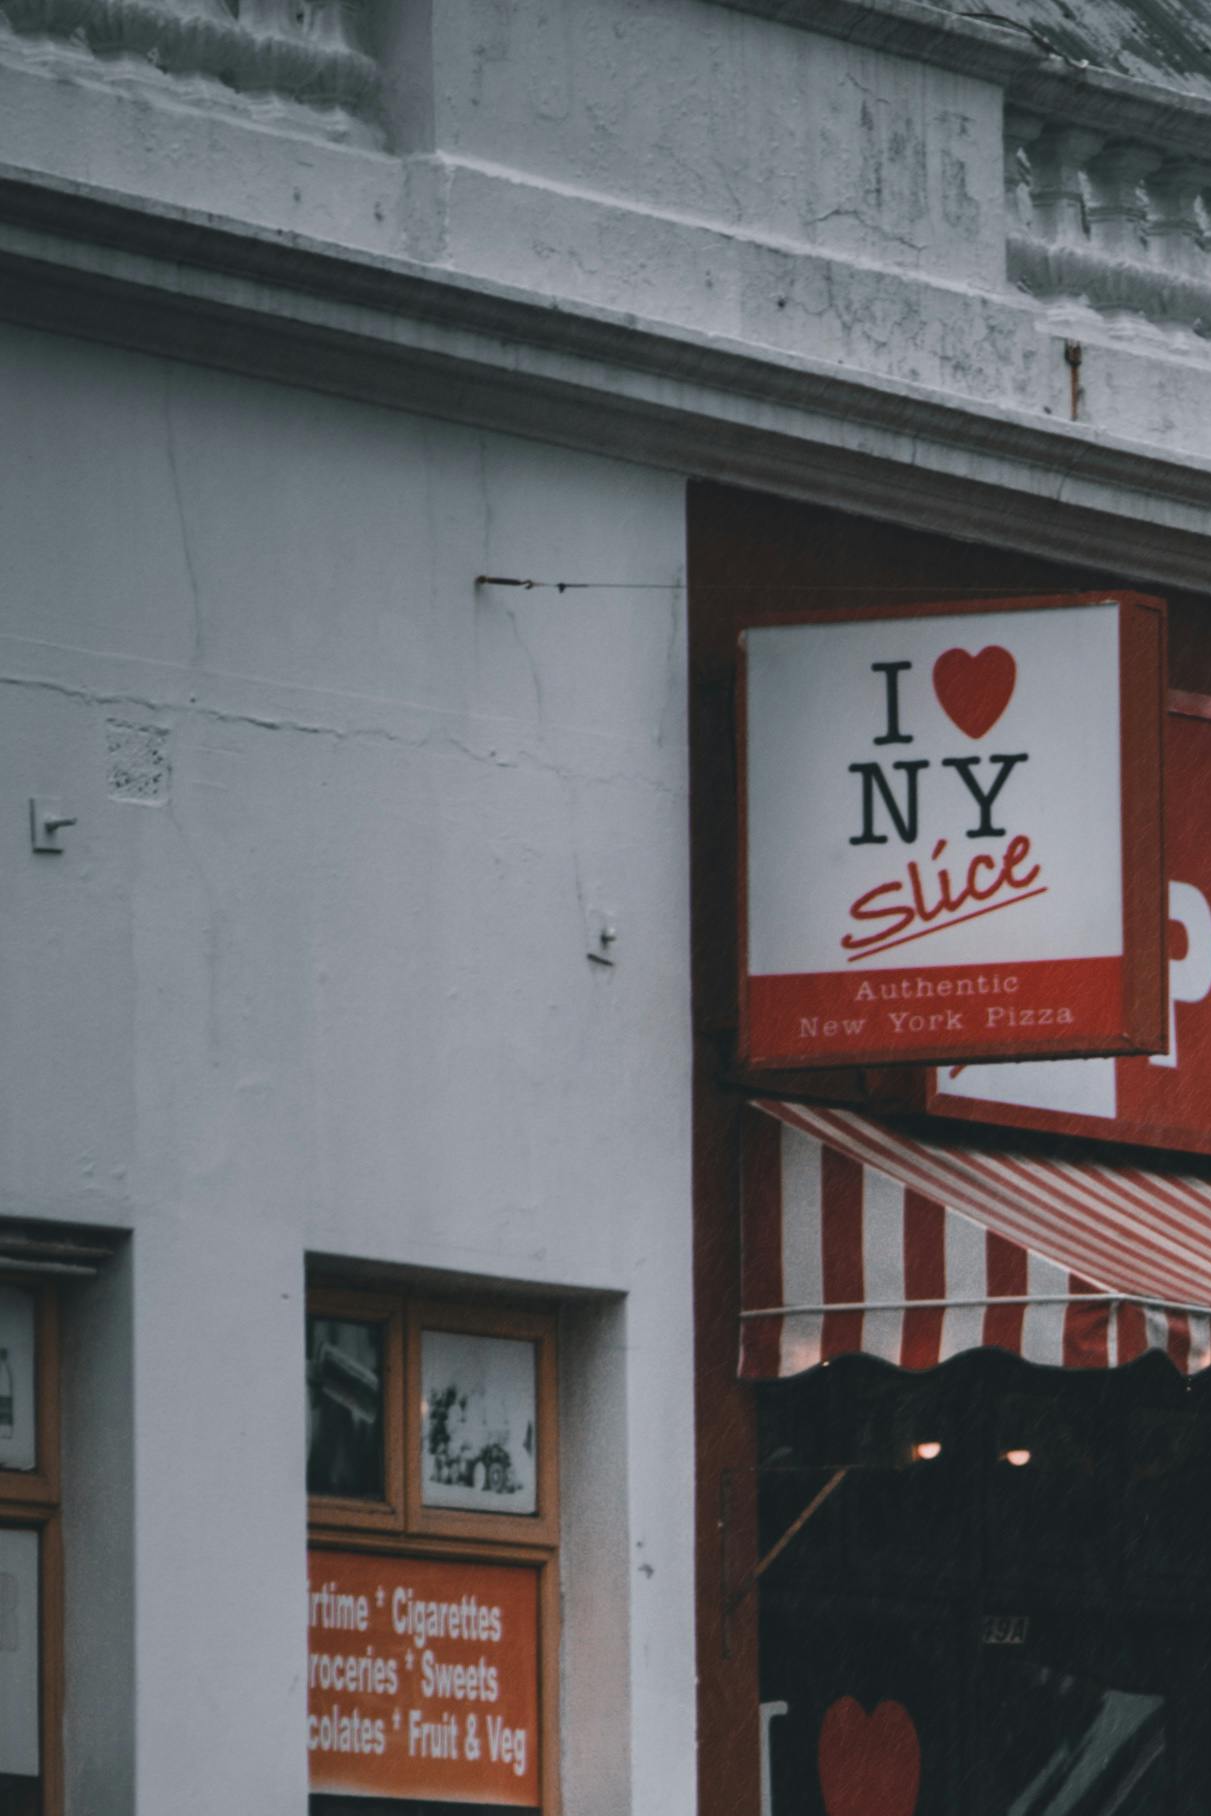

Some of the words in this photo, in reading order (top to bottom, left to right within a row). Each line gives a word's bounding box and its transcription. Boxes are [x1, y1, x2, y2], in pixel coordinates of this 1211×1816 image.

[871, 661, 914, 745] I
[849, 754, 1029, 846] NY
[854, 973, 1020, 1002] Authentic
[799, 1016, 866, 1039] New
[889, 1009, 963, 1034] York
[987, 1004, 1074, 1028] Pizza
[392, 1586, 503, 1648] Cigarettes
[421, 1650, 499, 1702] Sweets
[408, 1709, 458, 1760] Fruit
[464, 1712, 481, 1761] &
[487, 1715, 527, 1777] Veg
